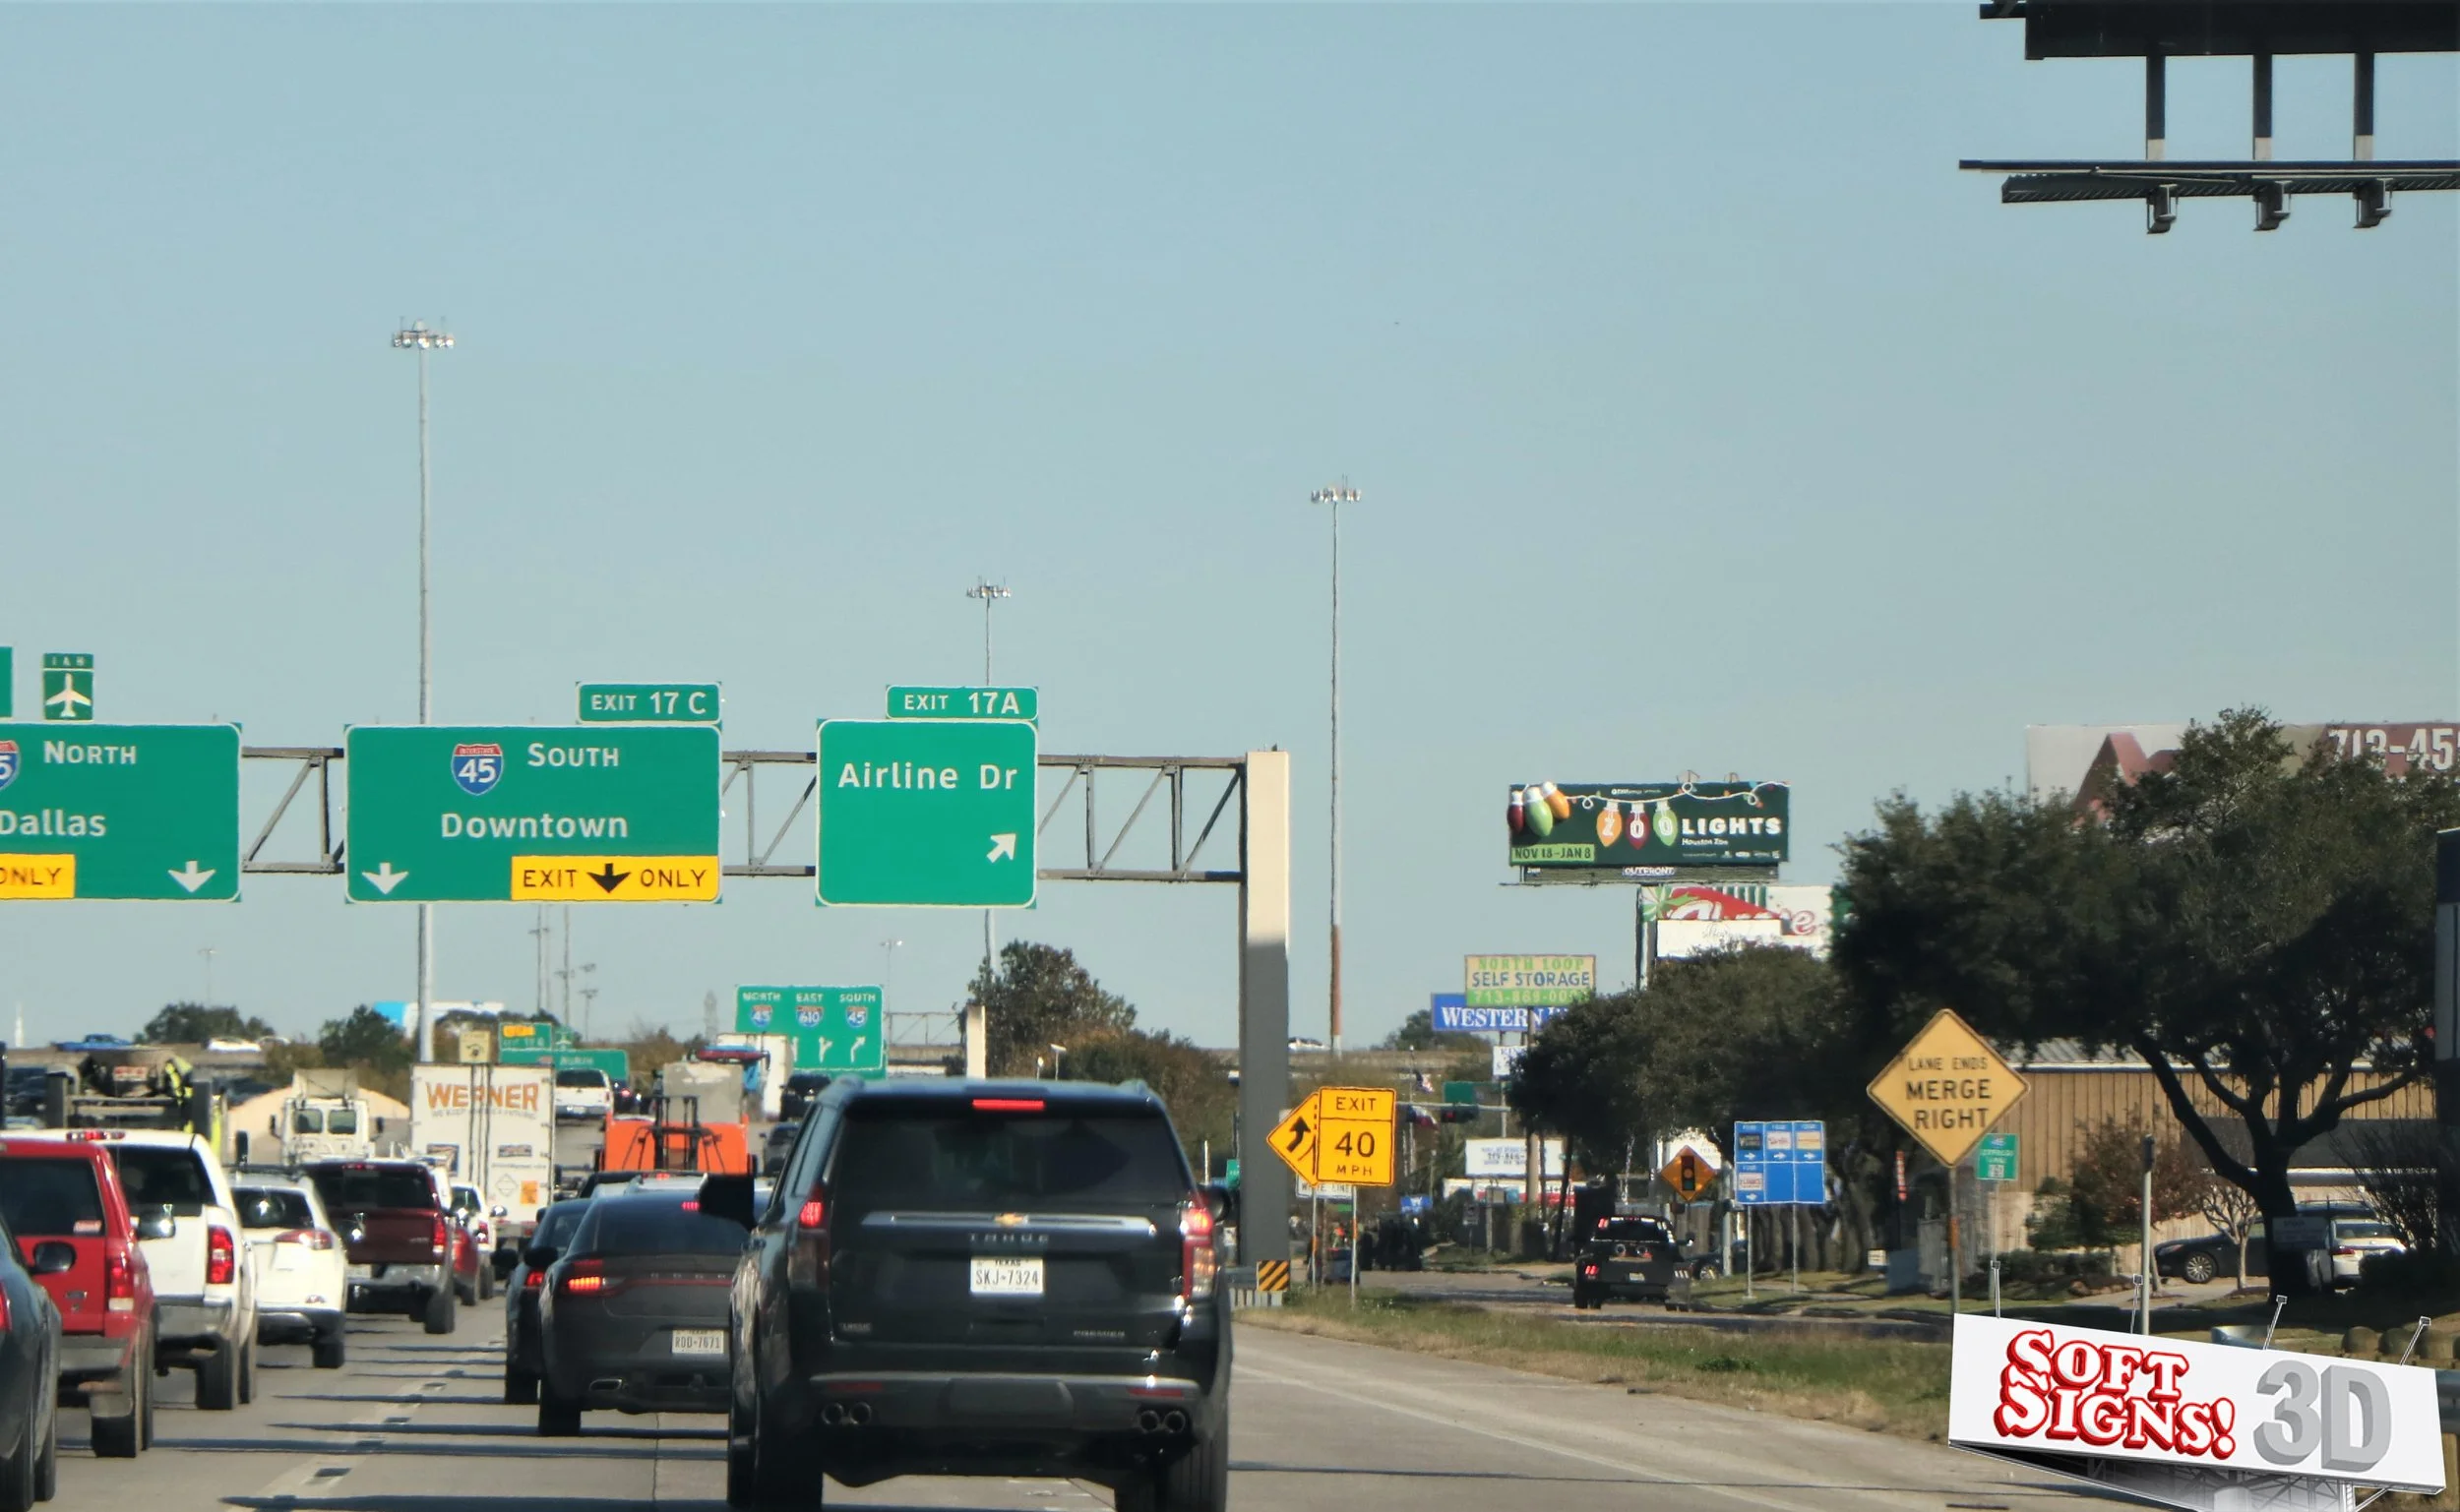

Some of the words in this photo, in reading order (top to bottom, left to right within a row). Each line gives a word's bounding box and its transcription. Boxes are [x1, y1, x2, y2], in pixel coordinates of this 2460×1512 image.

[591, 694, 638, 711] EXIT
[649, 692, 679, 714] 17
[689, 692, 707, 715] C
[904, 694, 949, 710] EXIT
[968, 692, 1020, 715] 17A
[43, 740, 138, 764] NORTH
[527, 743, 620, 767] SOUTH
[2328, 728, 2460, 770] 713-45
[458, 758, 497, 784] 45
[838, 761, 959, 790] Airline
[980, 763, 1018, 790] Dr
[0, 809, 107, 837] Dallas
[442, 813, 630, 838] Downtown
[1682, 816, 1782, 836] LIGHTS
[1515, 847, 1538, 859] NOV
[523, 869, 578, 888] EXIT
[641, 869, 707, 888] ONLY
[1624, 867, 1675, 877] OUTFRONT
[1479, 957, 1534, 970] NORTH
[1542, 958, 1584, 971] LOOP
[1472, 972, 1509, 987] SELF
[1515, 971, 1590, 987] STORAGE
[742, 992, 782, 1002] NORTH
[796, 993, 824, 1002] EAST
[839, 993, 876, 1003] SOUTH
[799, 1011, 821, 1023] 610
[848, 1011, 866, 1024] 45
[1442, 1006, 1543, 1027] WESTERN
[1908, 1057, 1943, 1071] LANE
[1952, 1057, 1988, 1070] ENDS
[425, 1081, 539, 1112] WERNER
[1905, 1079, 1993, 1101] MERGE
[1336, 1096, 1377, 1111] EXIT
[1914, 1108, 1989, 1130] RIGHT
[1334, 1131, 1376, 1158] 40
[1336, 1164, 1373, 1177] MPH
